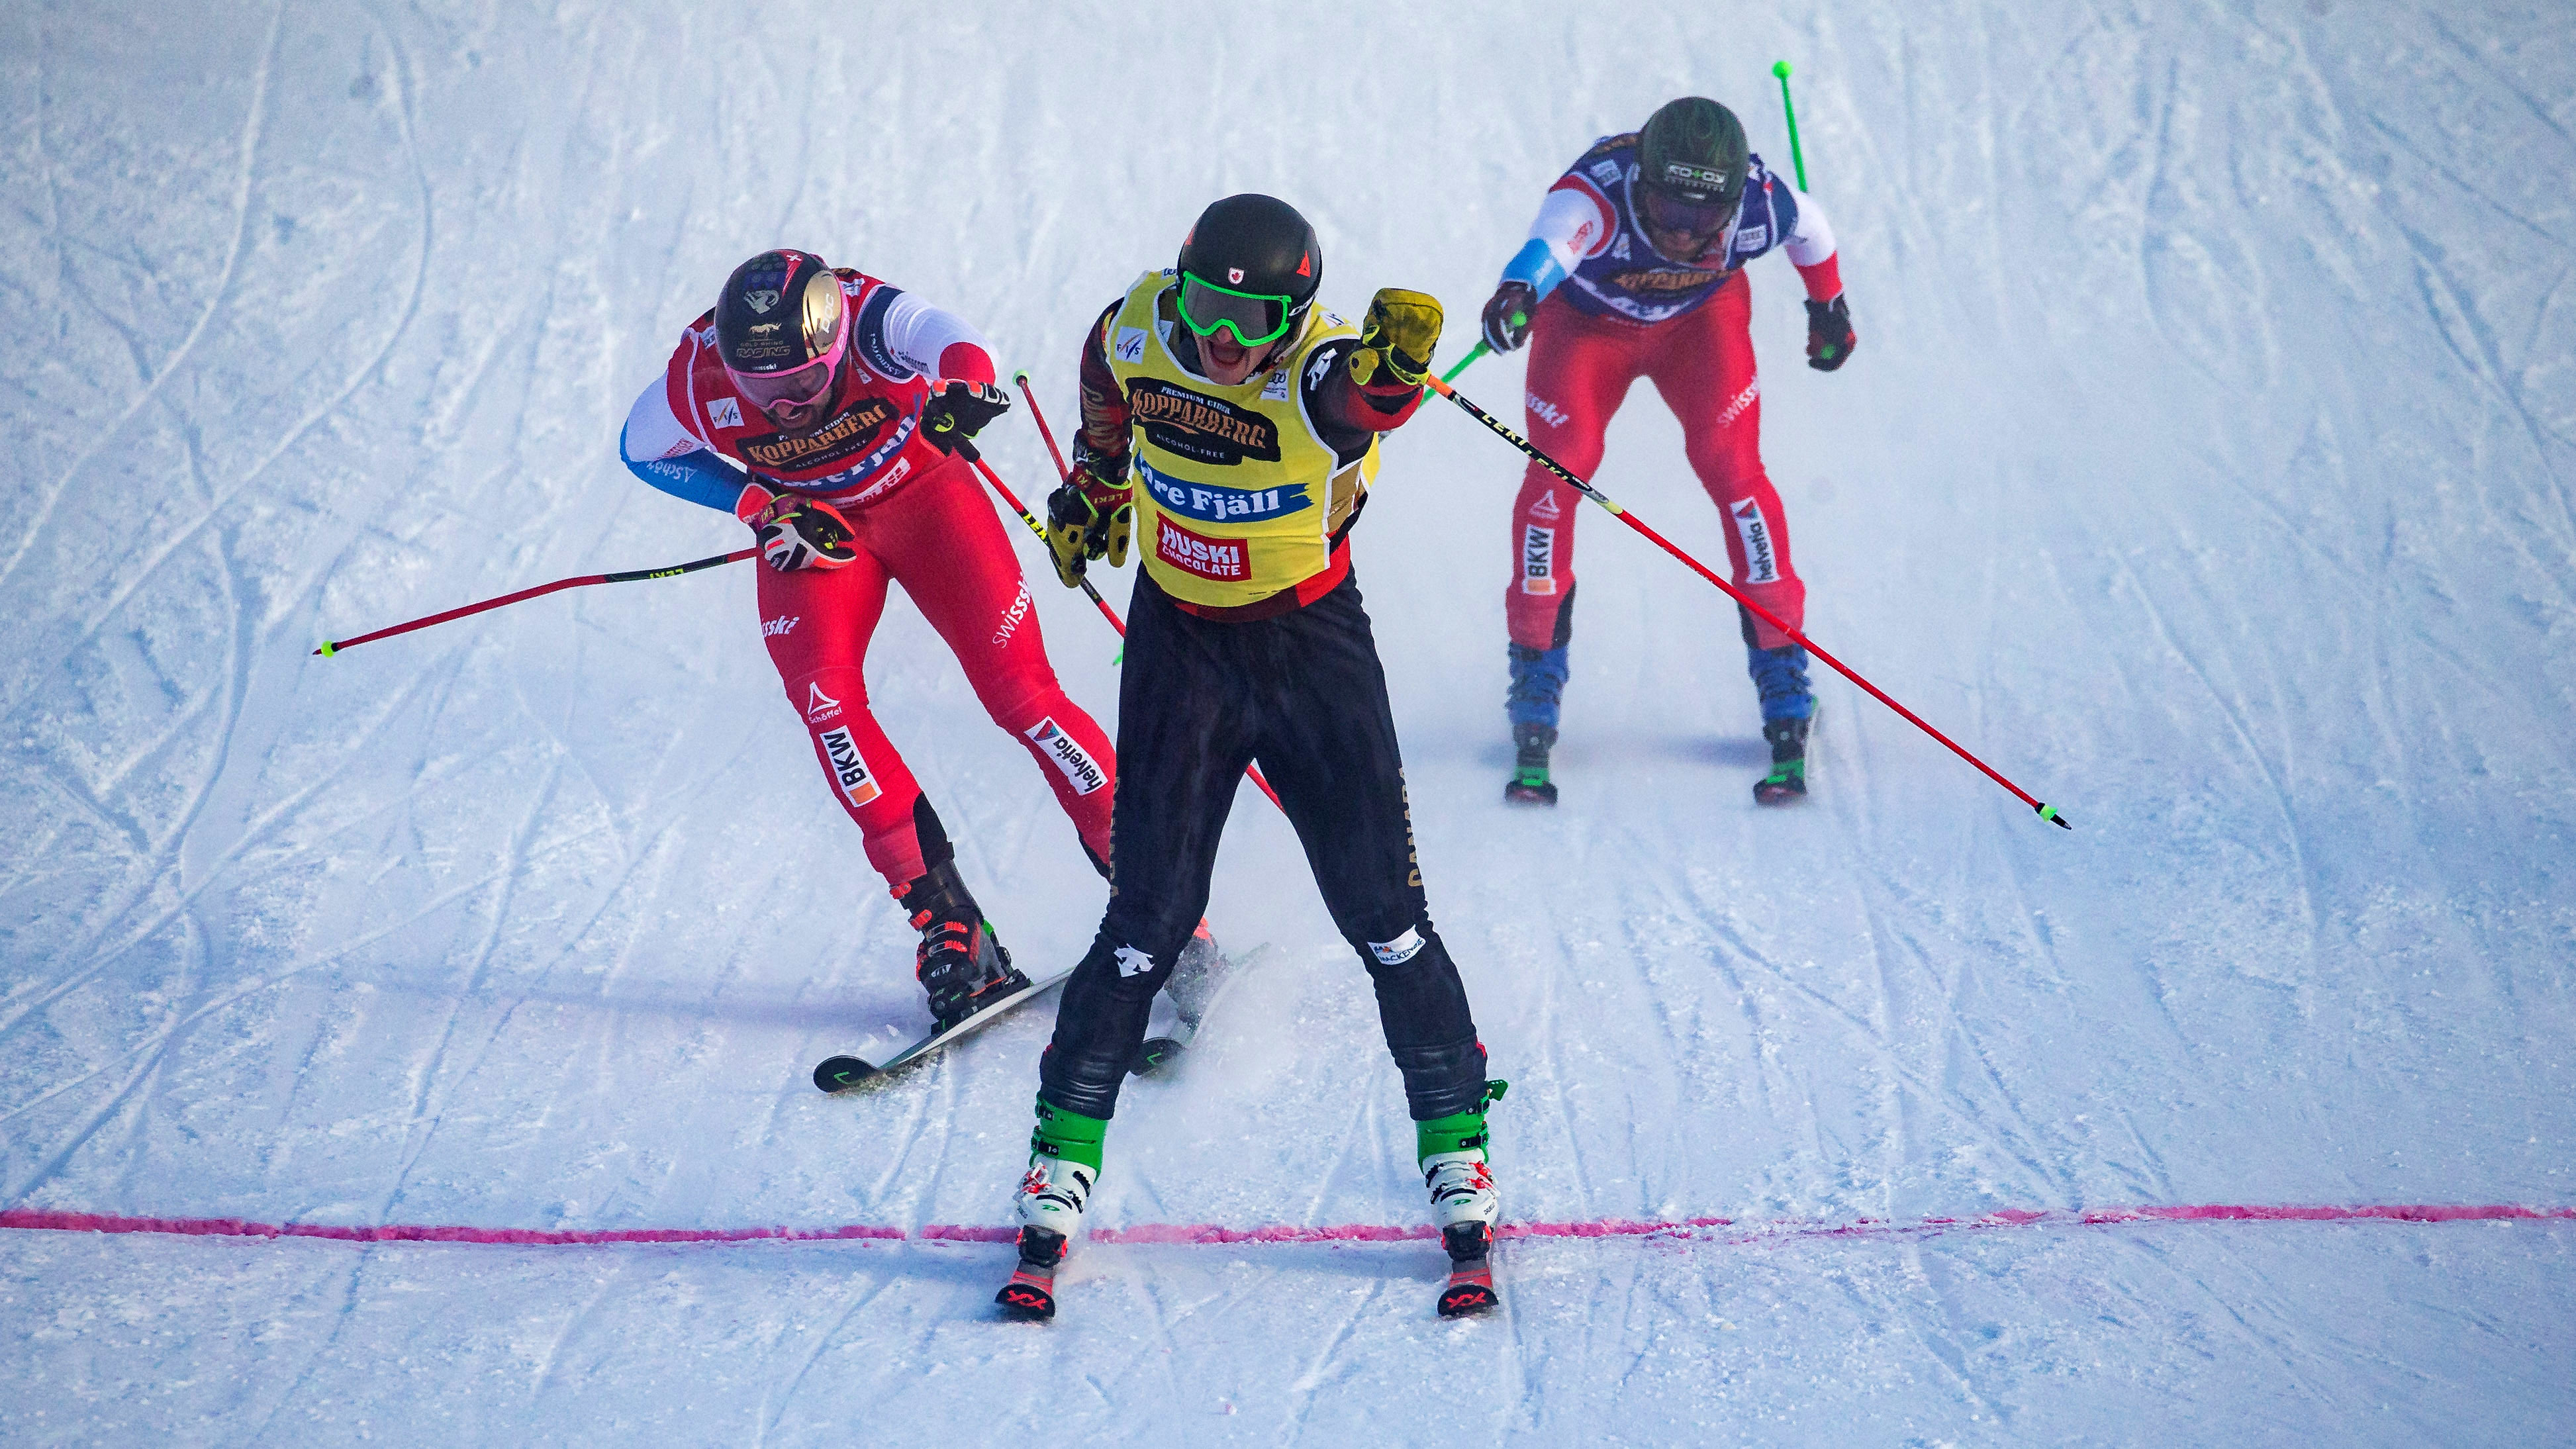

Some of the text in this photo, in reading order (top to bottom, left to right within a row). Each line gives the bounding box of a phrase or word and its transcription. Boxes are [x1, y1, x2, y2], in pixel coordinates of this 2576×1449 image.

[821, 293, 834, 334] POC
[736, 345, 791, 359] RACING
[1131, 389, 1266, 449] KOPPARBERG
[1161, 386, 1231, 416] PREMIUM CIDER
[1482, 414, 1527, 446] LEKI
[1190, 489, 1281, 520] Fjäll
[1162, 544, 1241, 577] CHOCOLATE
[1163, 523, 1240, 565] HUSKI
[1527, 528, 1550, 577] BKW
[823, 731, 867, 787] BKW
[1053, 736, 1103, 793] helvetia
